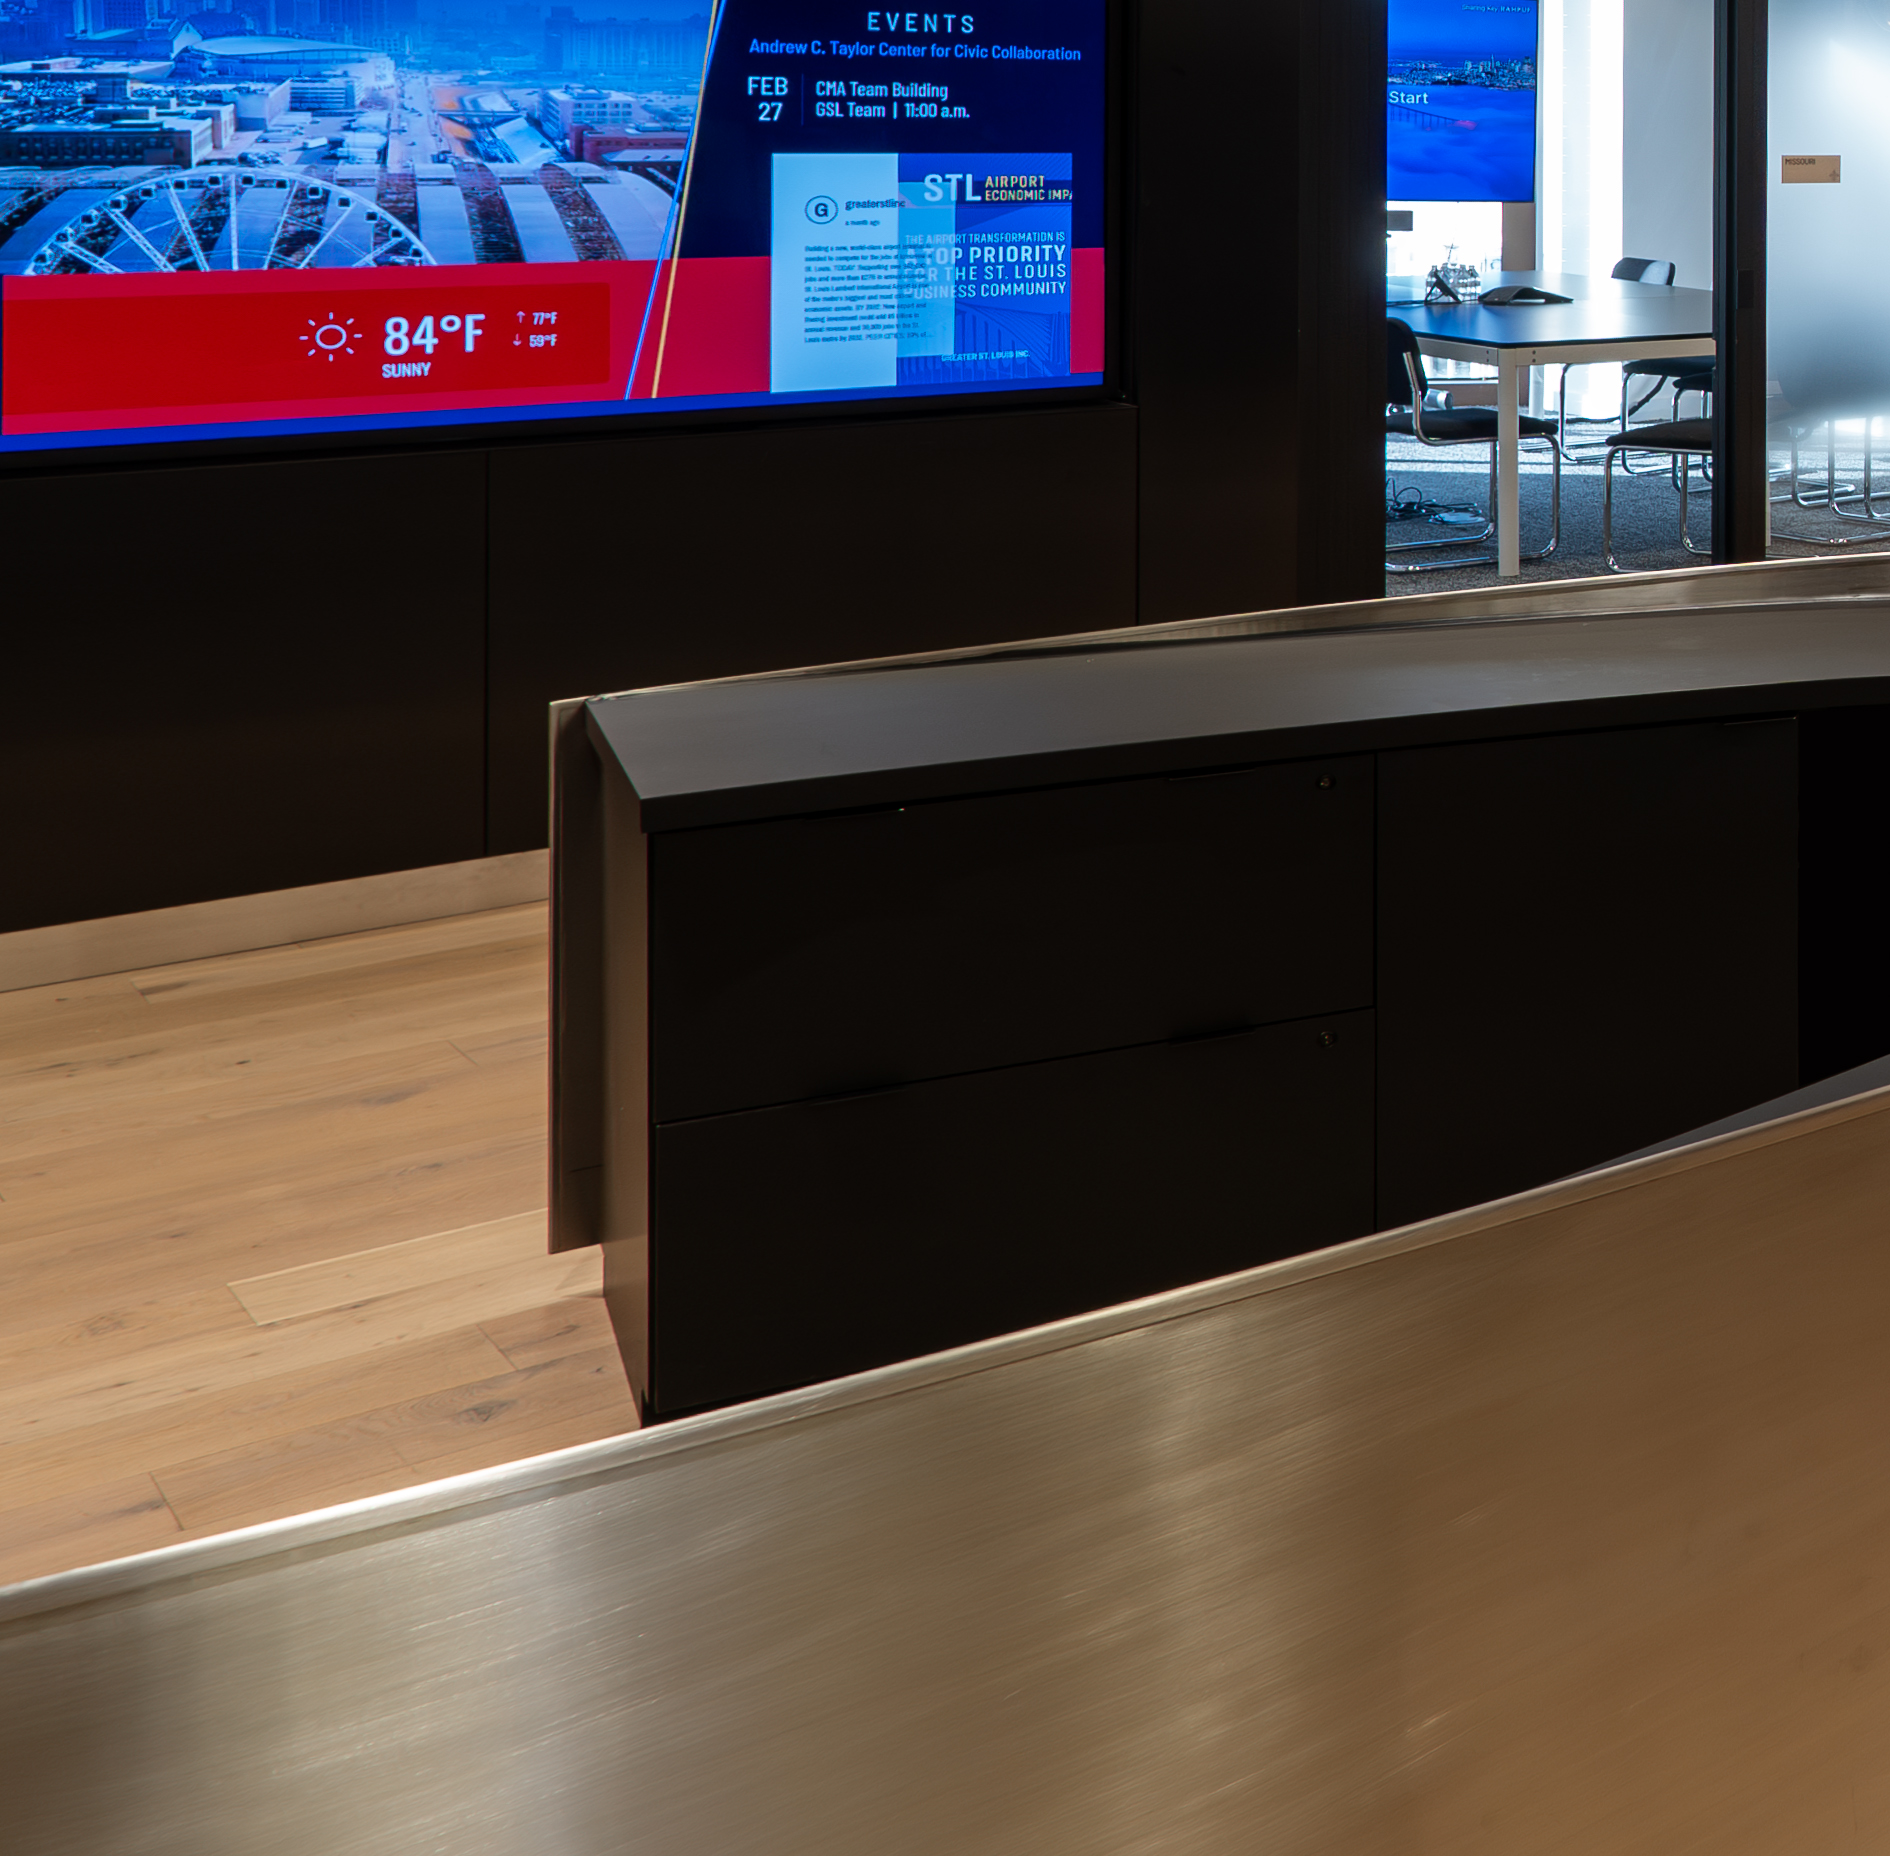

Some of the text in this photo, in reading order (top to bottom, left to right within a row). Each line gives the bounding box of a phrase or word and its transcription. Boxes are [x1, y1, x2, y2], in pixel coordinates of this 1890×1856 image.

[866, 10, 975, 35] EVENTS
[748, 38, 1082, 61] Andrew C. Taylor Center for Civic Collaboration
[747, 75, 789, 96] FEB
[815, 80, 949, 101] CMA Team Building
[1388, 90, 1429, 104] Start
[757, 102, 783, 122] 27
[815, 101, 971, 119] GSL Team 11:00 a.m.
[1784, 158, 1816, 166] MISSOURI
[923, 173, 1046, 202] STL AIRPORT
[984, 189, 1046, 202] ECONOMIC
[814, 202, 829, 218] G
[905, 230, 1066, 245] THE AIRPORT TRANSFORMATION IS
[921, 246, 963, 265] TOP
[968, 244, 1066, 265] PRIORITY
[944, 265, 978, 282] THE
[983, 264, 1009, 281] ST.
[1014, 262, 1067, 280] LOUIS
[979, 280, 1067, 298] COMMUNITY
[383, 312, 486, 357] 84°F
[381, 361, 432, 379] SUNNY
